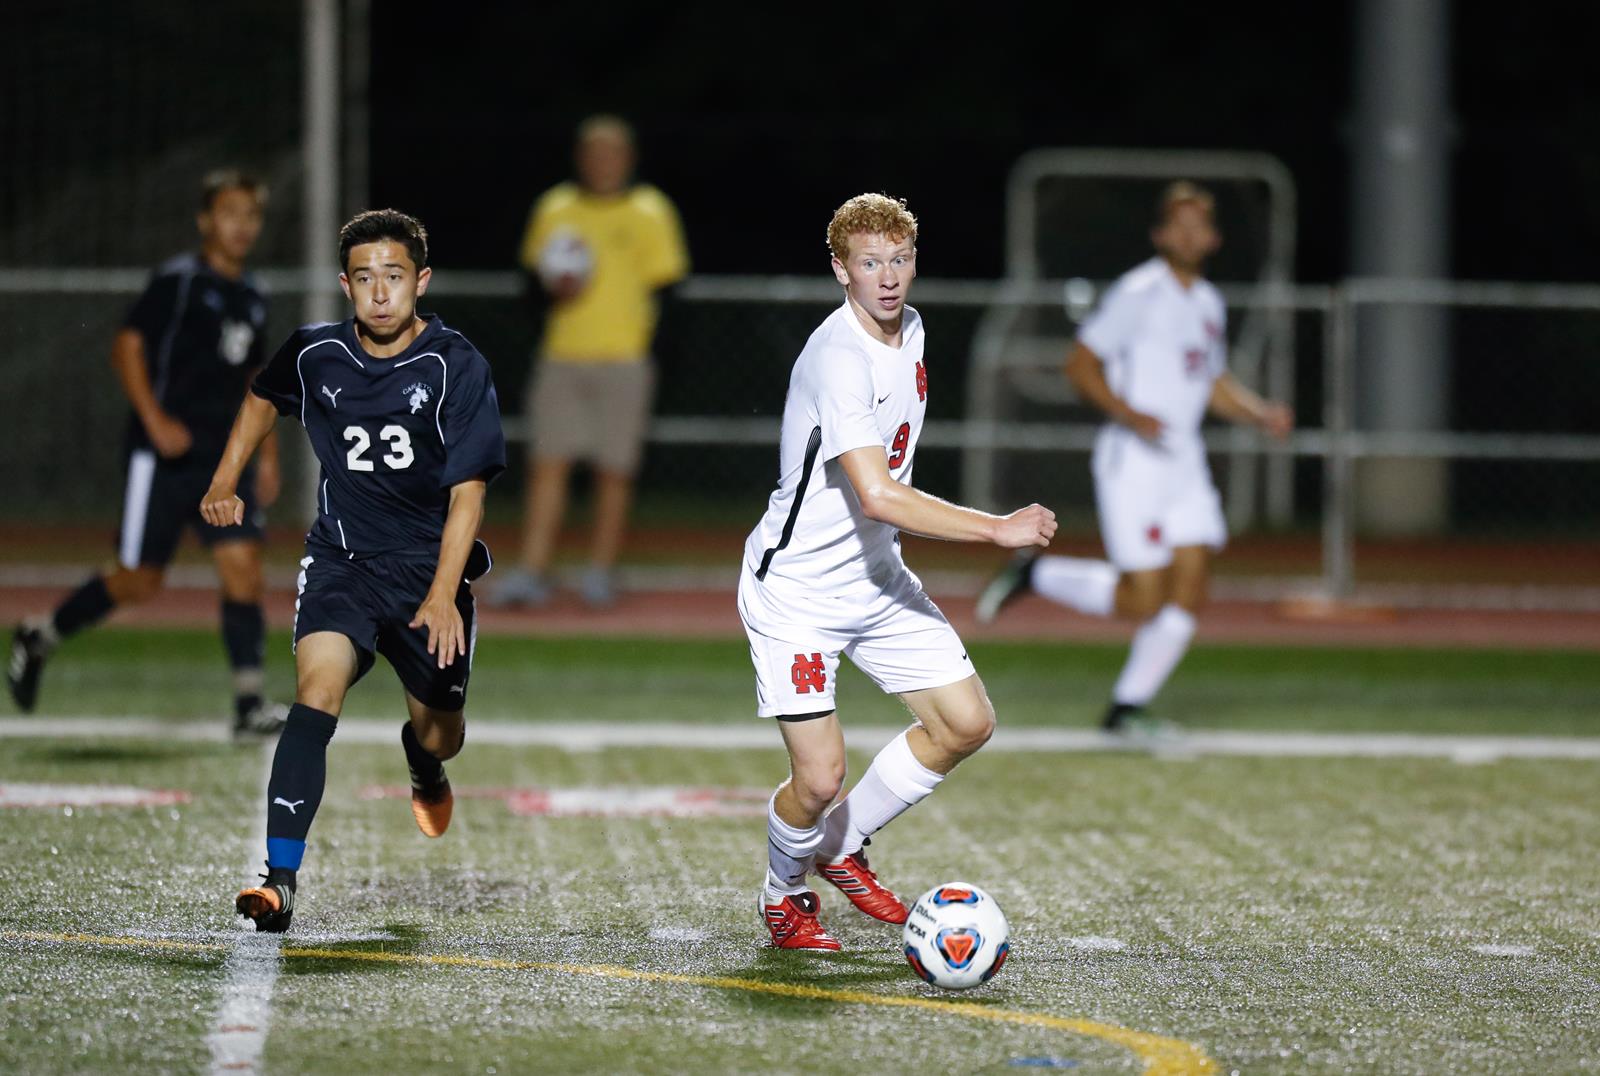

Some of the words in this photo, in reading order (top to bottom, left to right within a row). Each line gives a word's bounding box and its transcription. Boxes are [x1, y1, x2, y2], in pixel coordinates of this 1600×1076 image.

[343, 424, 415, 471] 23
[888, 421, 910, 470] 9
[908, 922, 926, 939] NCAA
